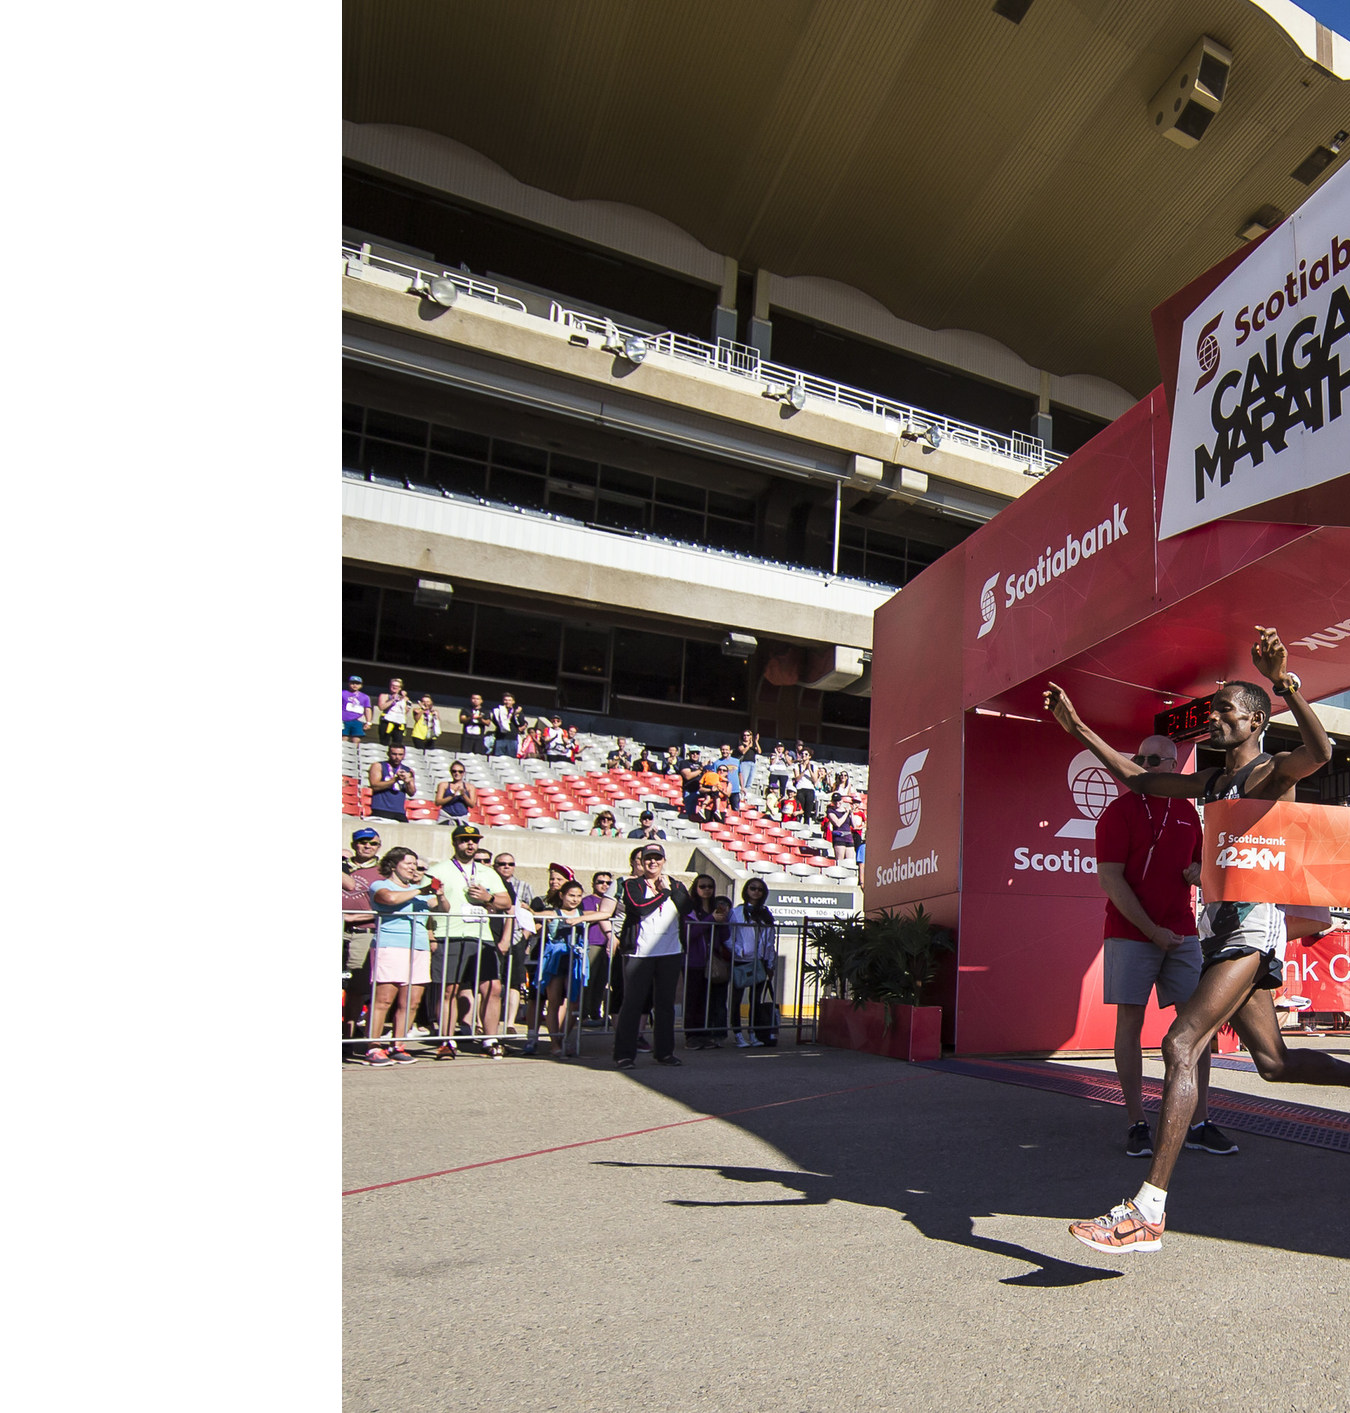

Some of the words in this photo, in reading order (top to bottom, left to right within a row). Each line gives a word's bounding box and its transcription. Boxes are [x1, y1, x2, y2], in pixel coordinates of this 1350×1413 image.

[1005, 503, 1129, 609] Scotiabank
[1228, 834, 1286, 846] Scotiabank
[876, 850, 938, 887] Scotiabank
[1216, 846, 1286, 872] 42.2KM
[778, 895, 802, 904] LEVEL
[803, 896, 809, 904] 1
[809, 896, 838, 905] NORTH
